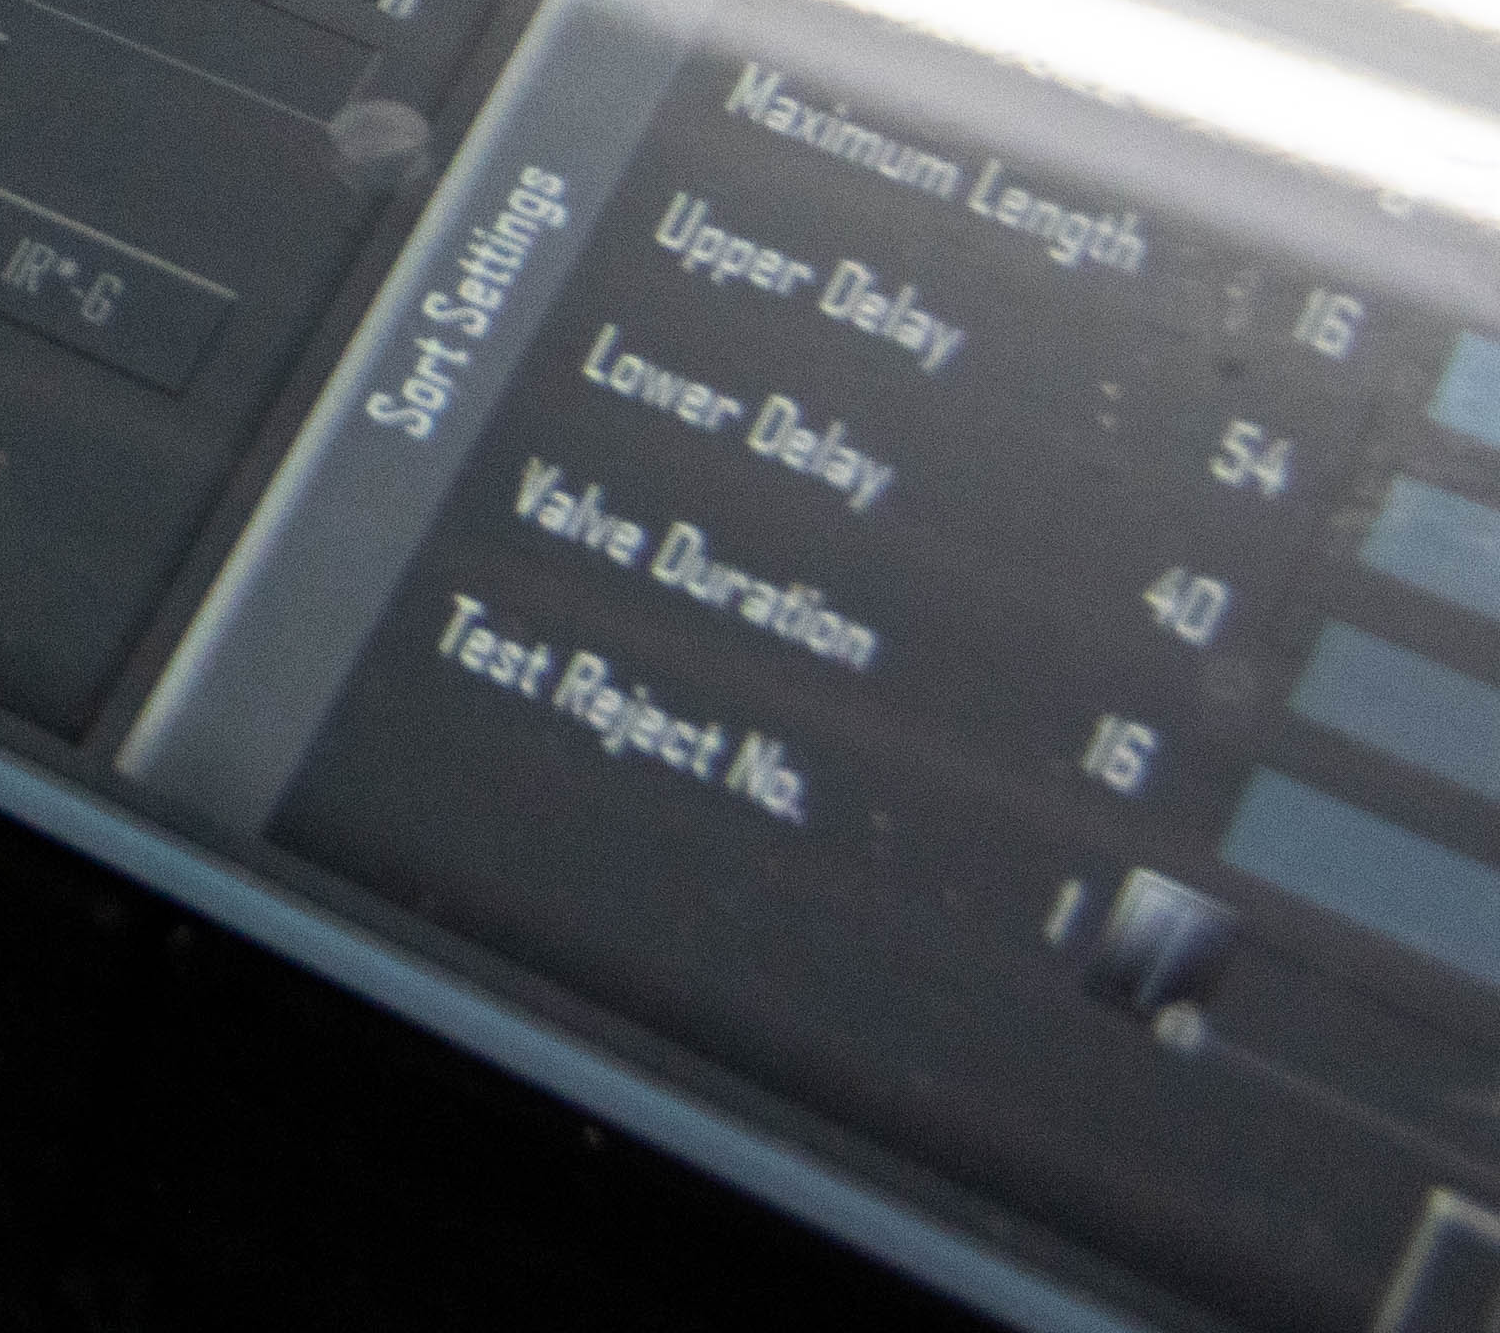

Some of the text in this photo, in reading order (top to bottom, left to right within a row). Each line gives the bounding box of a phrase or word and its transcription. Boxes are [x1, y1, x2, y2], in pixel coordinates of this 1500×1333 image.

[366, 165, 567, 440] Sort Settings
[655, 192, 1292, 496] Upper Delay 54
[724, 62, 964, 199] Maximum
[968, 157, 1148, 272] Length
[1296, 286, 1364, 362] 16
[515, 456, 1159, 796] Valve Duration 16
[583, 323, 1230, 646] Lower Delay 40
[439, 593, 551, 698] Test
[553, 650, 726, 781] Reject
